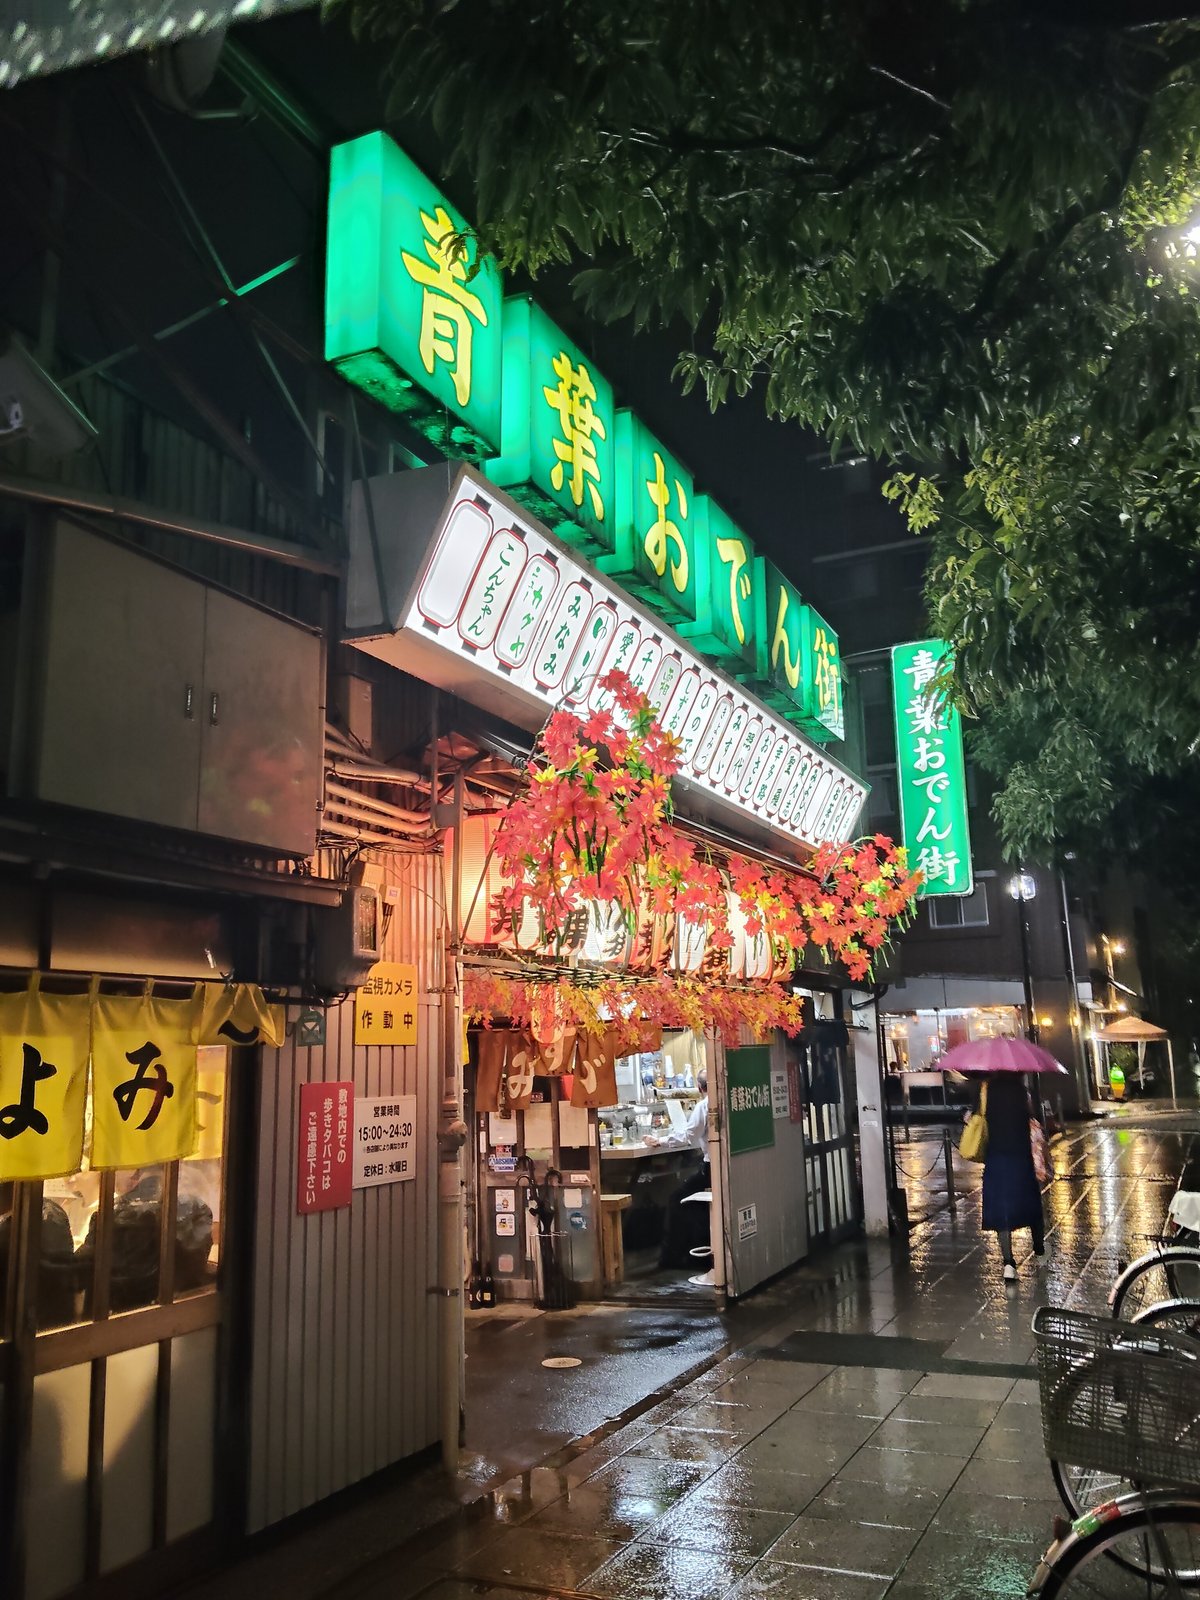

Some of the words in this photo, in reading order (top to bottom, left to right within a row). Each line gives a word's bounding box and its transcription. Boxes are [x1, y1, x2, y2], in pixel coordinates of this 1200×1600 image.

[401, 205, 838, 724] 青葉おでん街
[467, 542, 515, 637] こんちゃん
[543, 595, 582, 676] みなみ
[683, 693, 711, 755] ひので
[903, 649, 960, 887] 青葉おでん街
[361, 1010, 413, 1029] 作動中
[362, 976, 413, 996] 監視カメラ
[337, 1088, 348, 1164] 敷地内での
[373, 1104, 400, 1118] 営業時間
[730, 1084, 771, 1112] 青葉おでん街
[306, 1111, 318, 1205] ご遠慮下さい
[322, 1097, 333, 1190] 歩きタバコは
